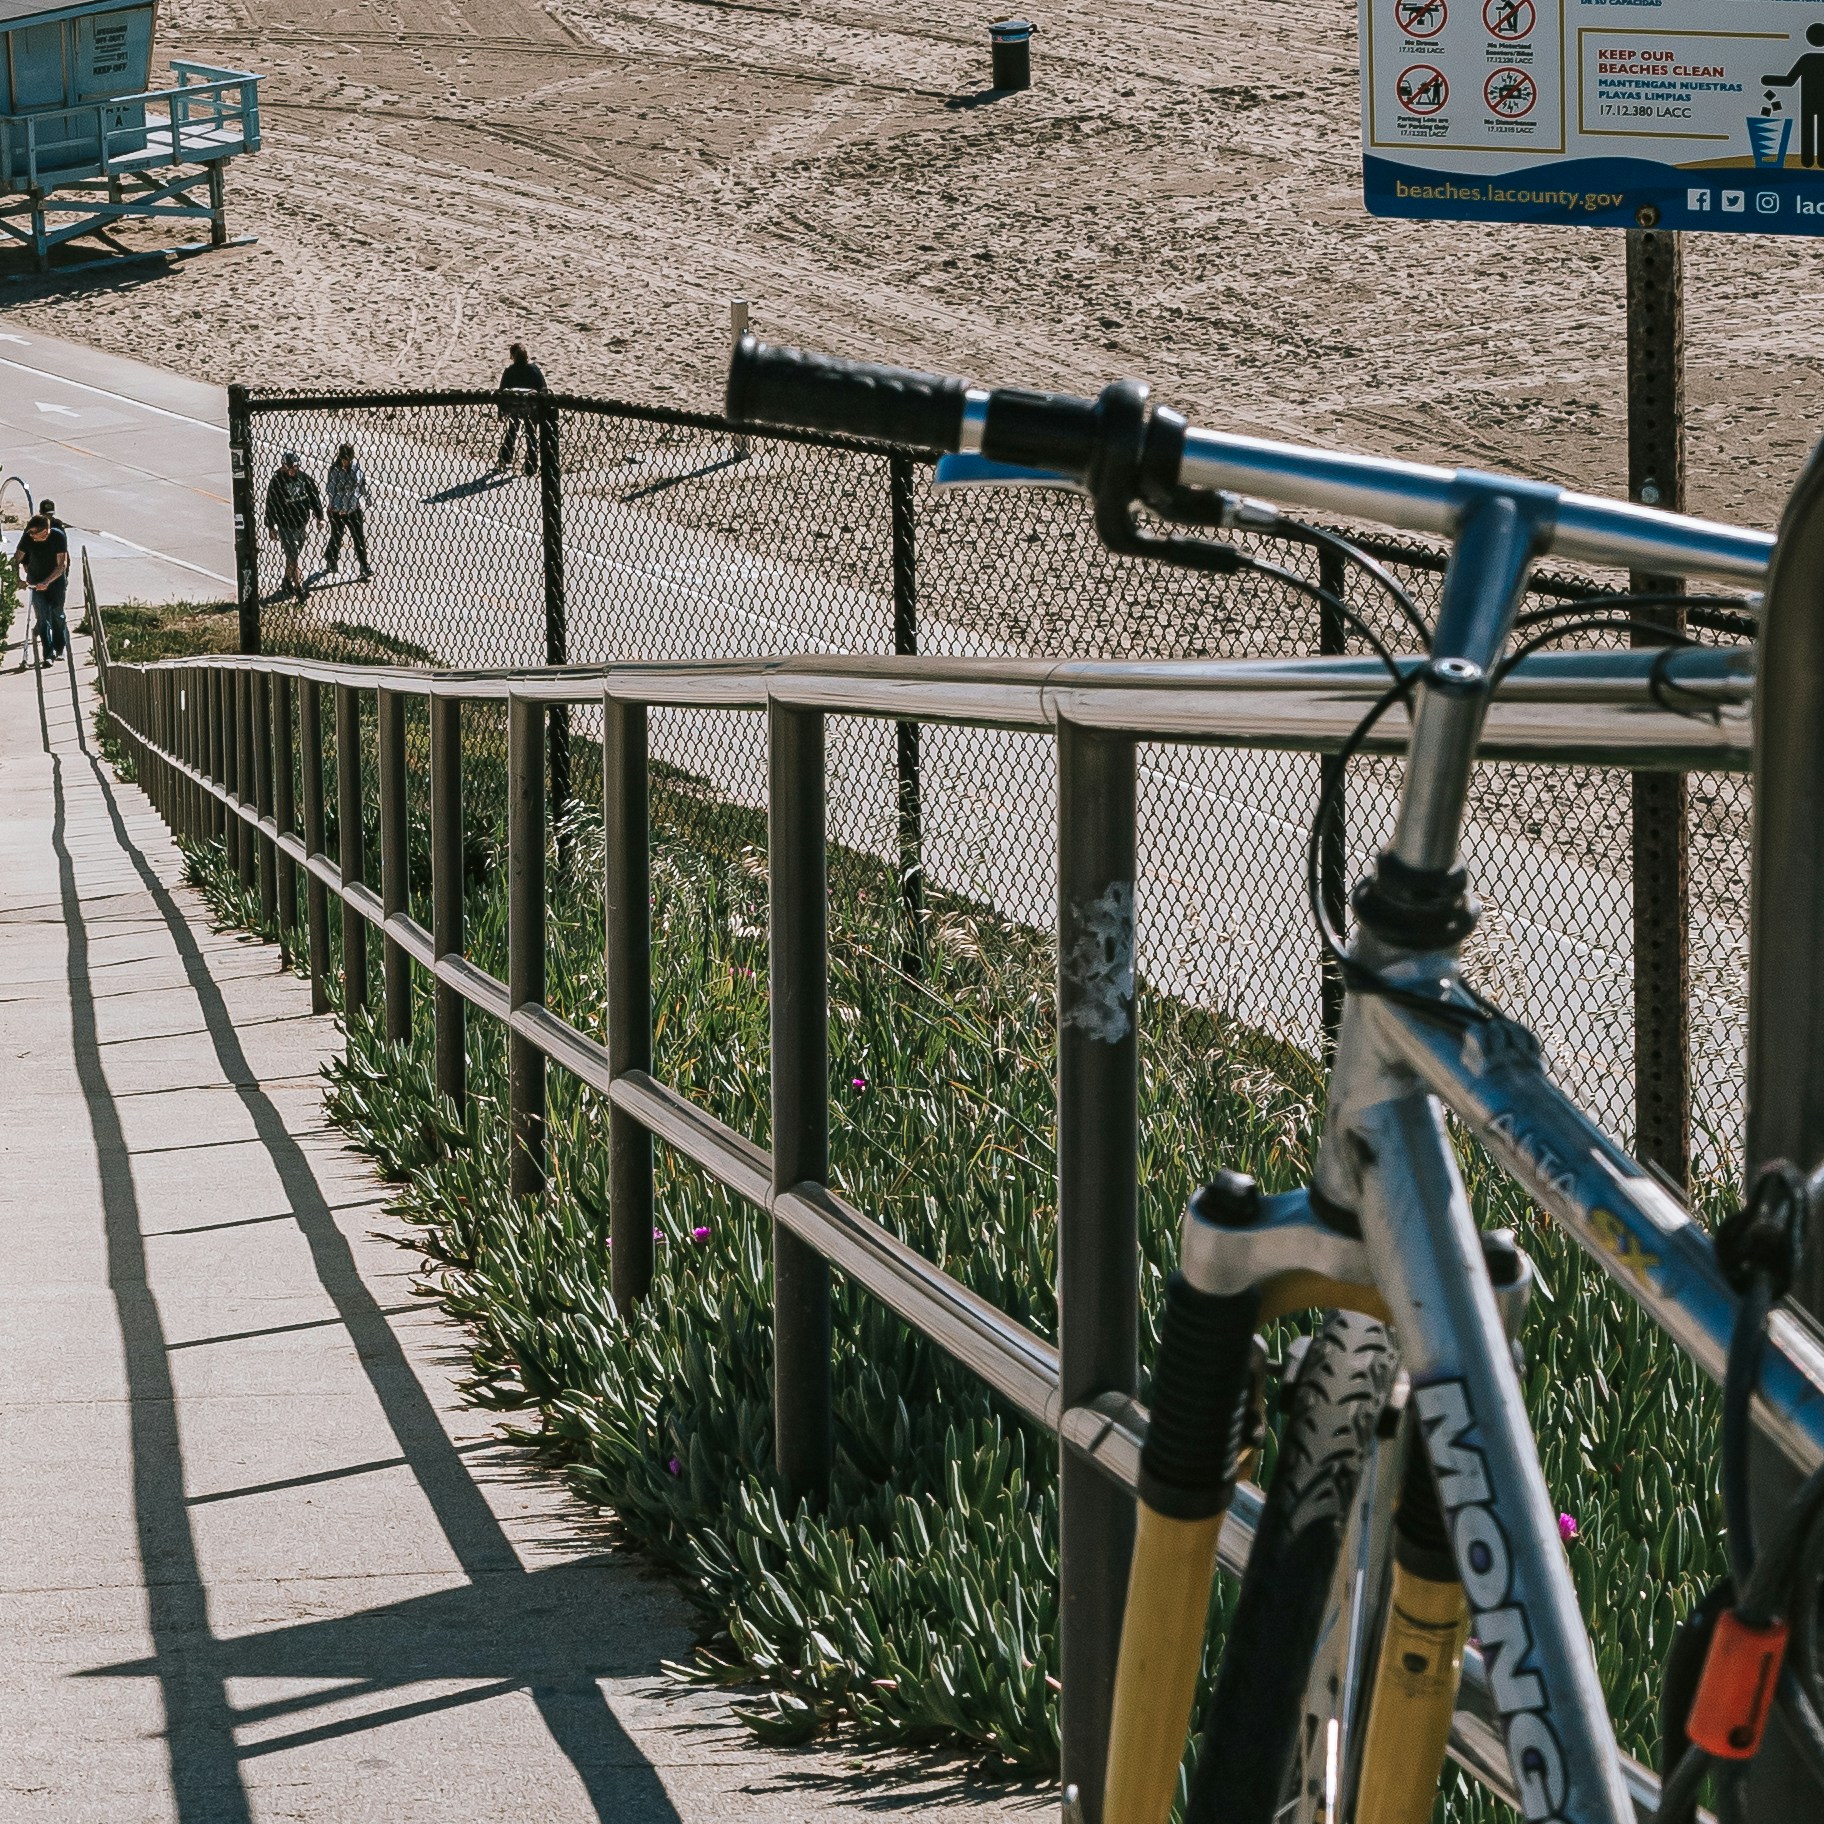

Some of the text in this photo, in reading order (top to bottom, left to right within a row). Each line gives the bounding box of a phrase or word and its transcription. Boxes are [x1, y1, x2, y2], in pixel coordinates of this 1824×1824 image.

[1598, 49, 1675, 62] KEEP OUR
[1598, 63, 1725, 78] BEACHES CLEAN
[1598, 78, 1743, 92] MANTENGAN NUESTRAS
[1598, 91, 1692, 102] PLAYAS LIMPIAS
[1600, 104, 1692, 118] 17.12.380 LACC
[1395, 179, 1624, 211] beaches.lacounty.gov
